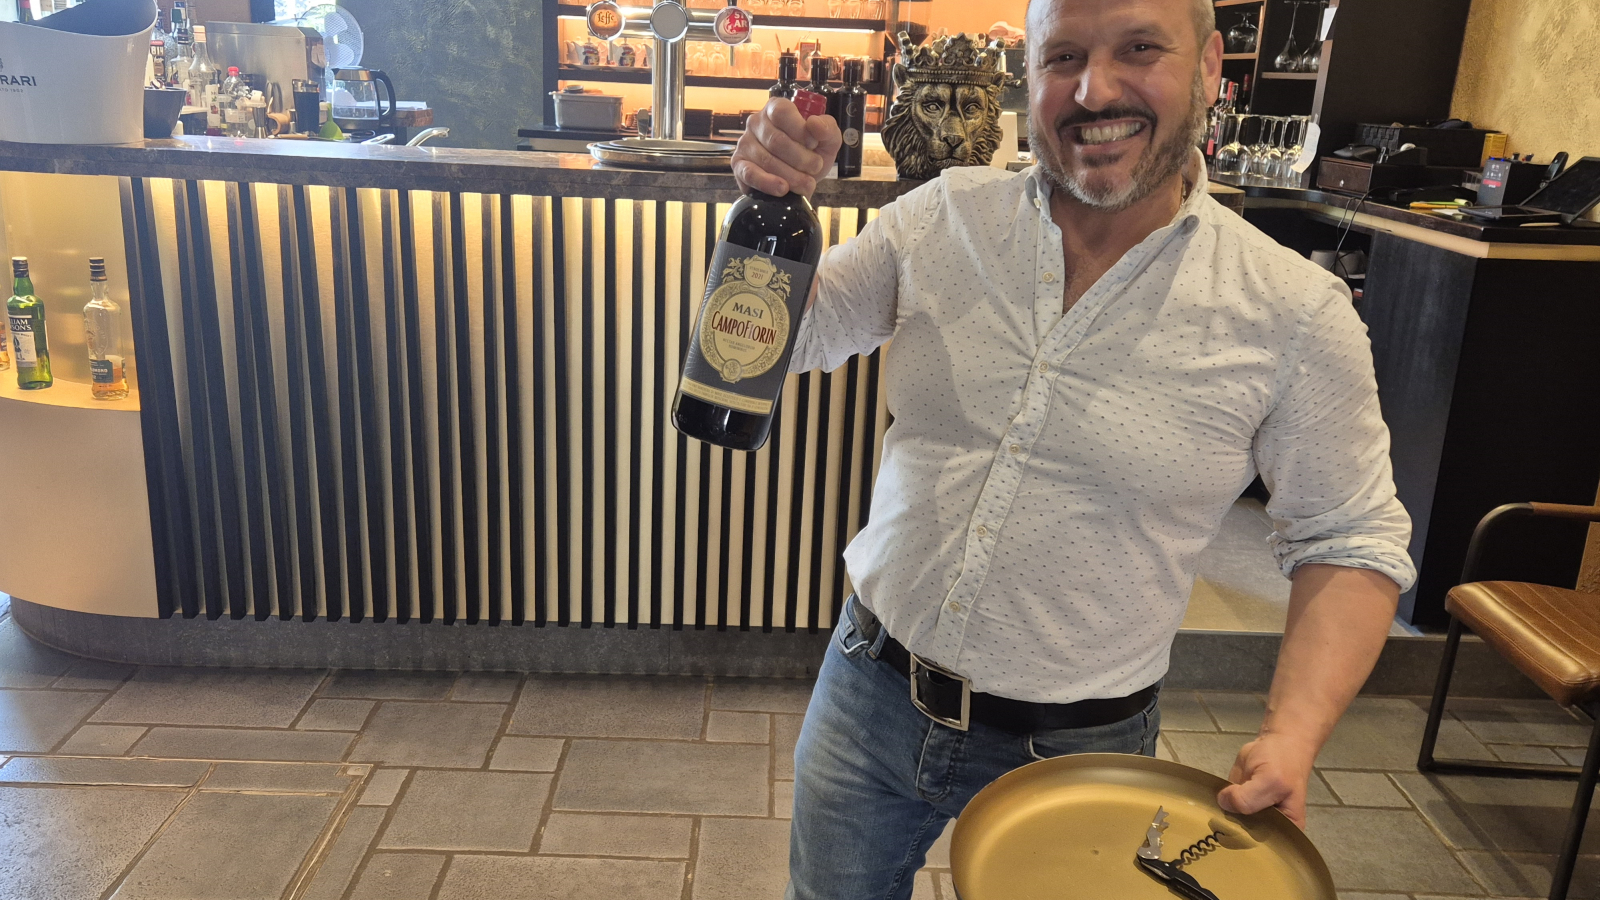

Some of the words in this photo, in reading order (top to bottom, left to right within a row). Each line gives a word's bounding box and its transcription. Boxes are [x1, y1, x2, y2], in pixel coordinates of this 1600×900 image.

[597, 11, 615, 25] Leffe
[0, 74, 37, 87] RARI
[751, 271, 764, 280] 2021
[732, 302, 764, 319] MASI
[711, 310, 778, 345] CAMPOFIORIN
